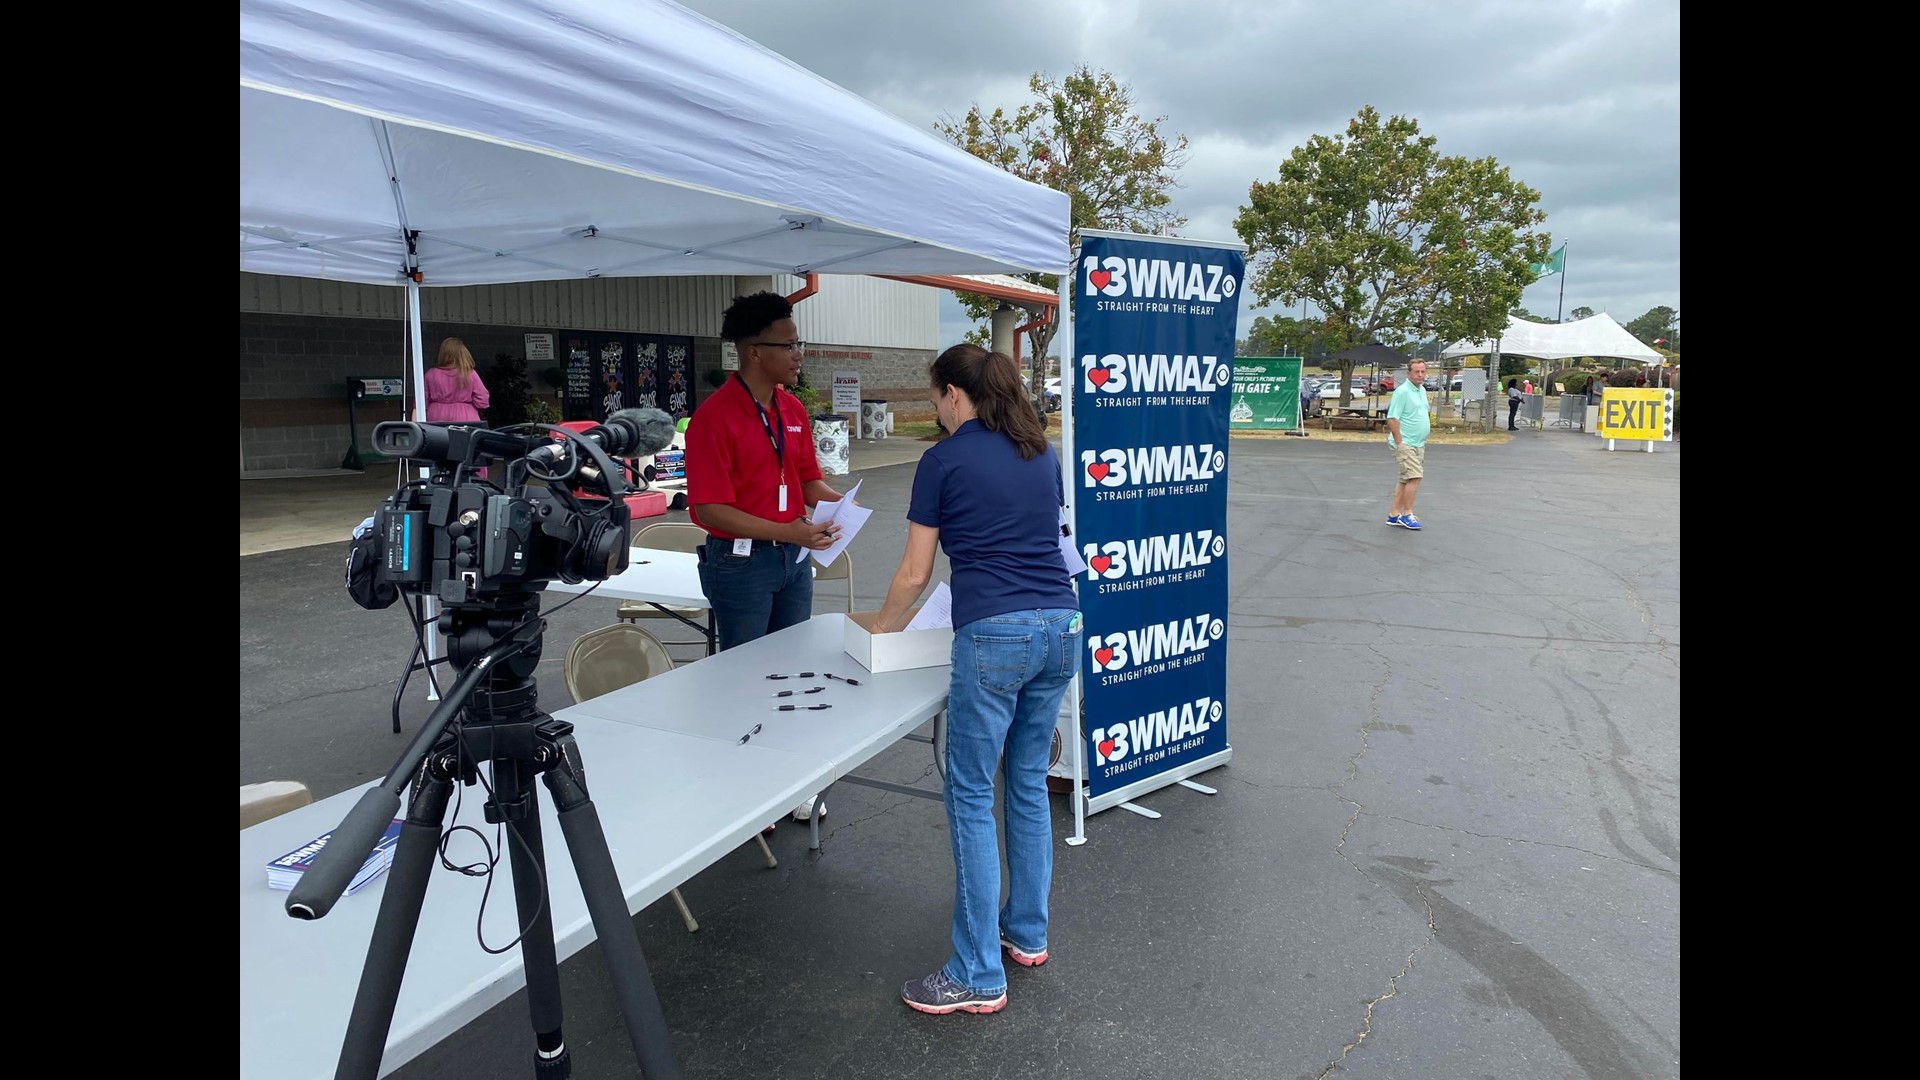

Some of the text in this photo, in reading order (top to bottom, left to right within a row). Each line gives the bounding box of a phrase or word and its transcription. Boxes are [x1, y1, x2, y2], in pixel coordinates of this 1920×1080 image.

[1084, 256, 1223, 302] 13WMAZ
[1098, 301, 1214, 315] STRAIGHT FROM THE HEART
[1082, 354, 1217, 393] 13WMAZ
[1232, 383, 1271, 393] TH GATE
[603, 390, 622, 413] SHOP
[669, 391, 687, 411] SHOP
[1096, 397, 1209, 407] STRAIGHT FROM THE HEART
[1606, 400, 1661, 429] EXIT
[1082, 444, 1213, 487] 13WMAZ
[1097, 484, 1208, 501] STRAIGHT FROM THE HEART
[1083, 530, 1212, 580] 13WMAZ
[1100, 569, 1205, 593] STRAIGHT FROM THE HEART
[1088, 614, 1209, 673] 13WMAZ
[1103, 653, 1204, 685] STRAIGHT FROM THE HEART
[1092, 697, 1210, 766] 13WMAZ
[1105, 736, 1204, 777] STRAIGHT FROM THE HEART
[275, 835, 332, 866] 13WMA
